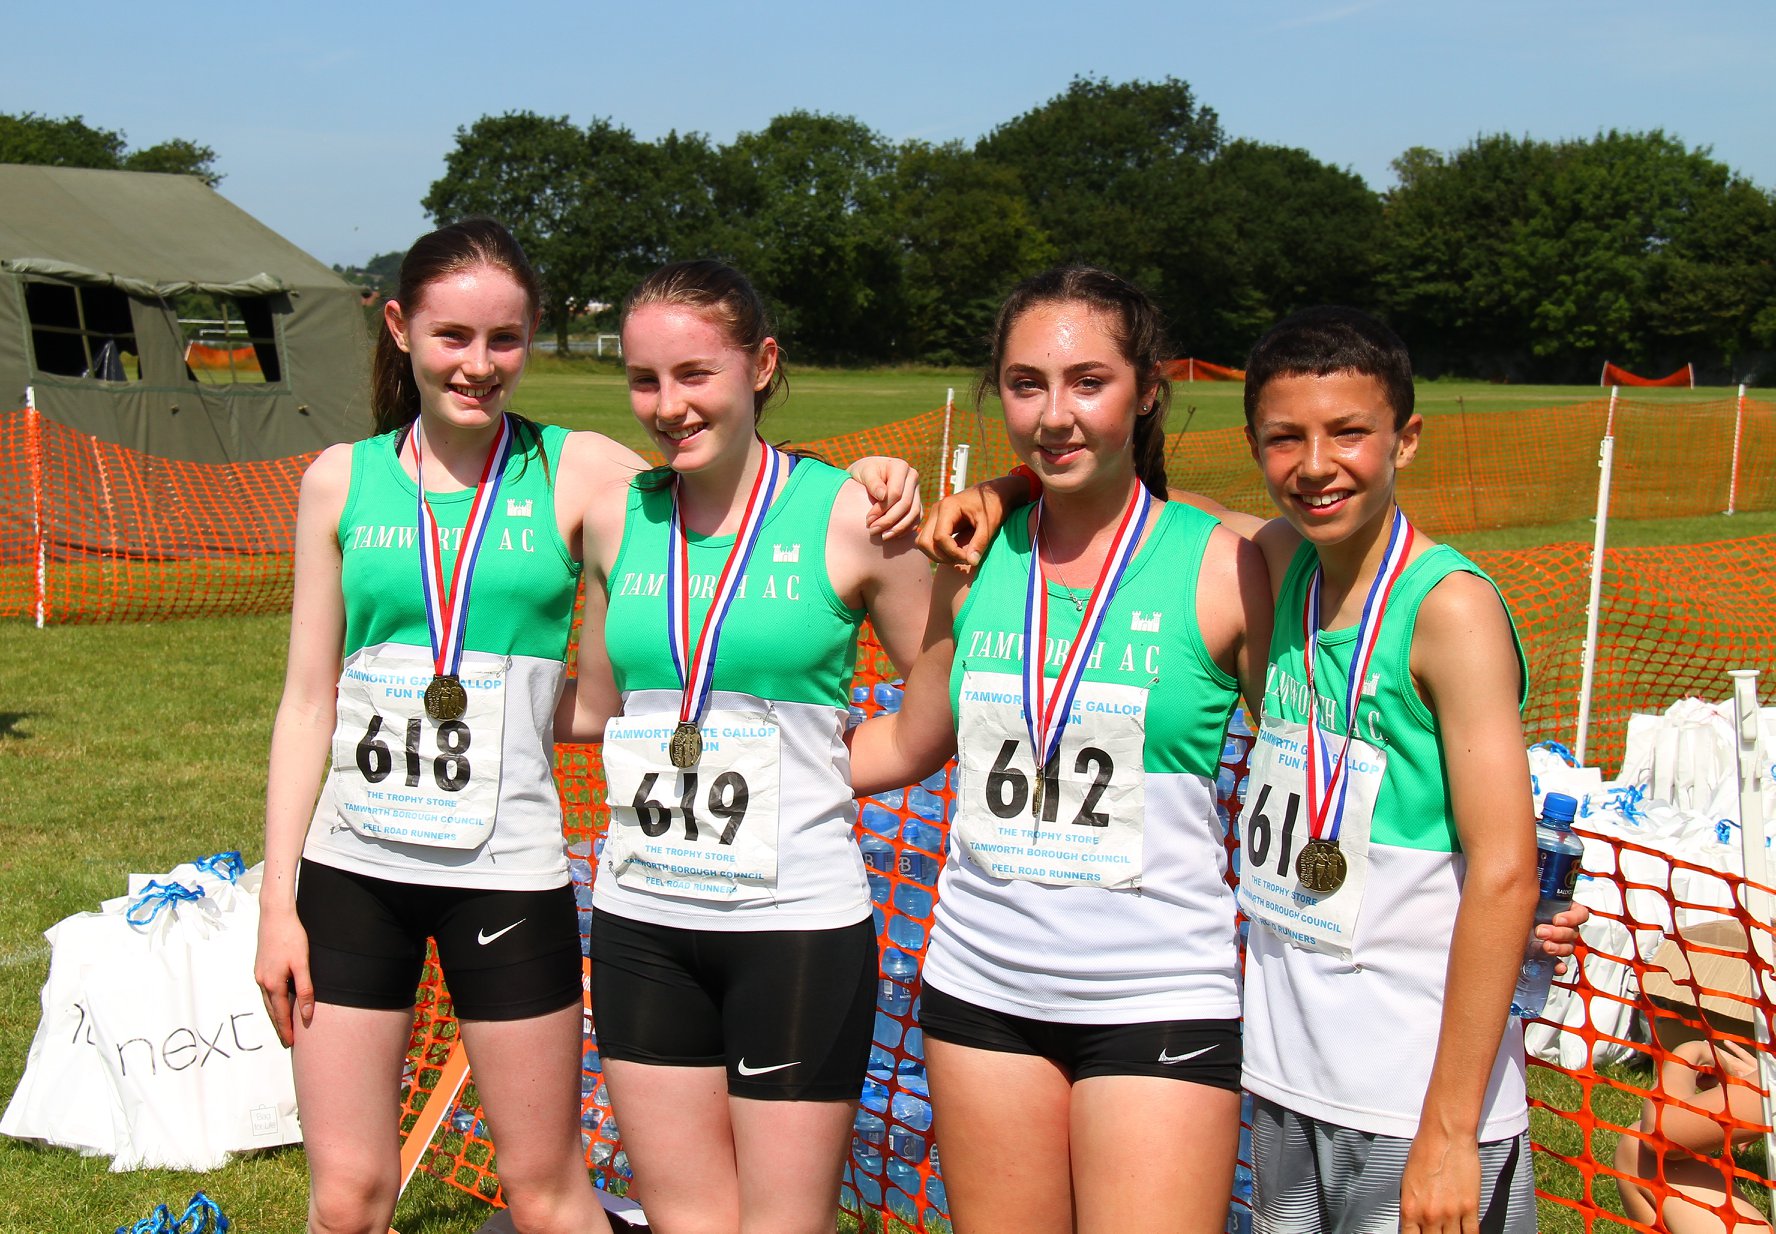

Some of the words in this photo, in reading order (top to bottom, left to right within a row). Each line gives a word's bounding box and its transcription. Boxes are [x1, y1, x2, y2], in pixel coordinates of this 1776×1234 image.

[352, 525, 470, 550] TAMWRT
[619, 573, 750, 599] TAMORH
[966, 631, 1106, 669] TAMORH
[345, 668, 405, 686] TAMWORTH
[460, 679, 502, 690] ALLOP
[385, 688, 412, 699] FUN
[964, 690, 1022, 704] TAMWOR
[1086, 701, 1142, 715] GALLOP
[723, 727, 776, 738] GALLOP
[356, 715, 472, 792] 618
[702, 742, 719, 752] UN
[1279, 753, 1300, 769] FUN
[986, 739, 1114, 828] 612
[367, 790, 384, 799] THE
[387, 793, 424, 804] TROPHY
[426, 798, 457, 807] STORE
[631, 772, 749, 845] 619
[344, 803, 390, 816] TAMWORTH
[393, 810, 437, 822] BOROUGH
[440, 816, 485, 826] COUNCIL
[363, 823, 381, 832] PEEL
[384, 827, 408, 835] ROAD
[411, 829, 456, 840] RUNNERS
[998, 827, 1017, 836] THE
[1021, 829, 1062, 840] TROPHY
[1065, 834, 1100, 845] STORE
[1247, 783, 1301, 878] 61
[645, 845, 662, 854] THE
[666, 847, 702, 858] TROPHY
[705, 852, 736, 862] STORE
[970, 842, 1023, 855] TAMWORTH
[1027, 848, 1078, 861] BOROUGH
[1081, 854, 1131, 864] COUNCIL
[646, 876, 664, 887] PEEL
[667, 881, 691, 890] ROAD
[672, 866, 717, 877] BOROUGH
[720, 870, 764, 880] COUNCIL
[992, 863, 1014, 873] PEEL
[1018, 866, 1046, 876] ROAD
[1050, 870, 1101, 881] RUNNERS
[1251, 875, 1261, 886] THE
[1263, 880, 1290, 897] TROPHY
[1291, 891, 1318, 906] STORE
[1265, 900, 1300, 919] BOROUGH
[1300, 914, 1342, 933] COUNCIL
[1277, 925, 1316, 945] RUNNERS
[117, 1012, 264, 1077] next
